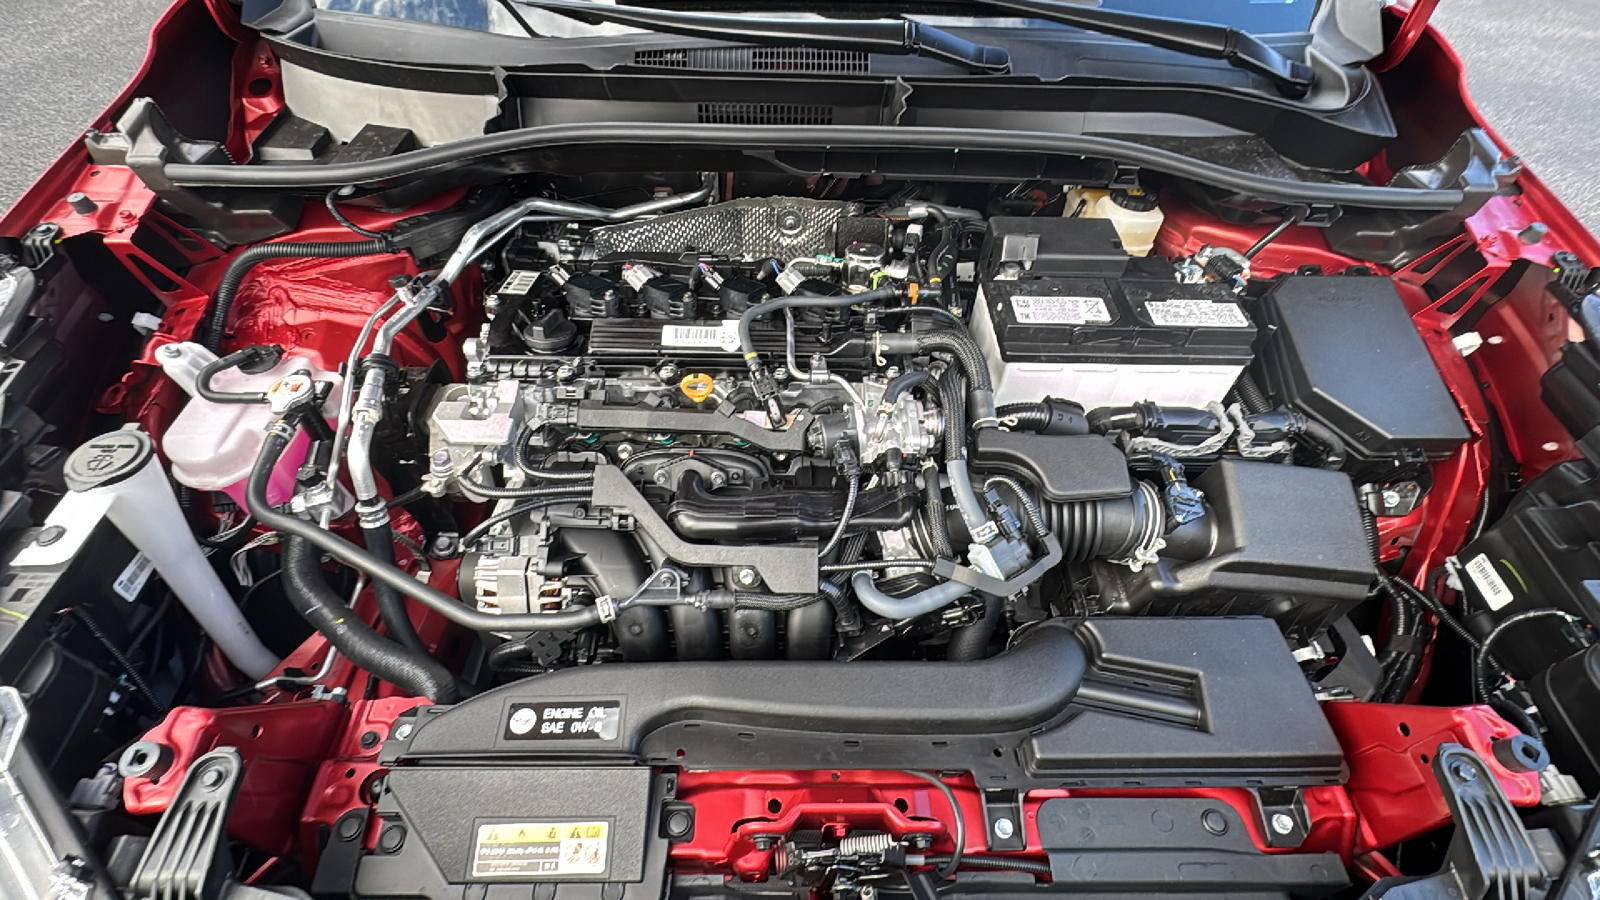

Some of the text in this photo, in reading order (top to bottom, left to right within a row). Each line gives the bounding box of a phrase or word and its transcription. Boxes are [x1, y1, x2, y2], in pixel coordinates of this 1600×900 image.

[543, 706, 608, 719] ENGINE OIL
[540, 721, 565, 734] SAE
